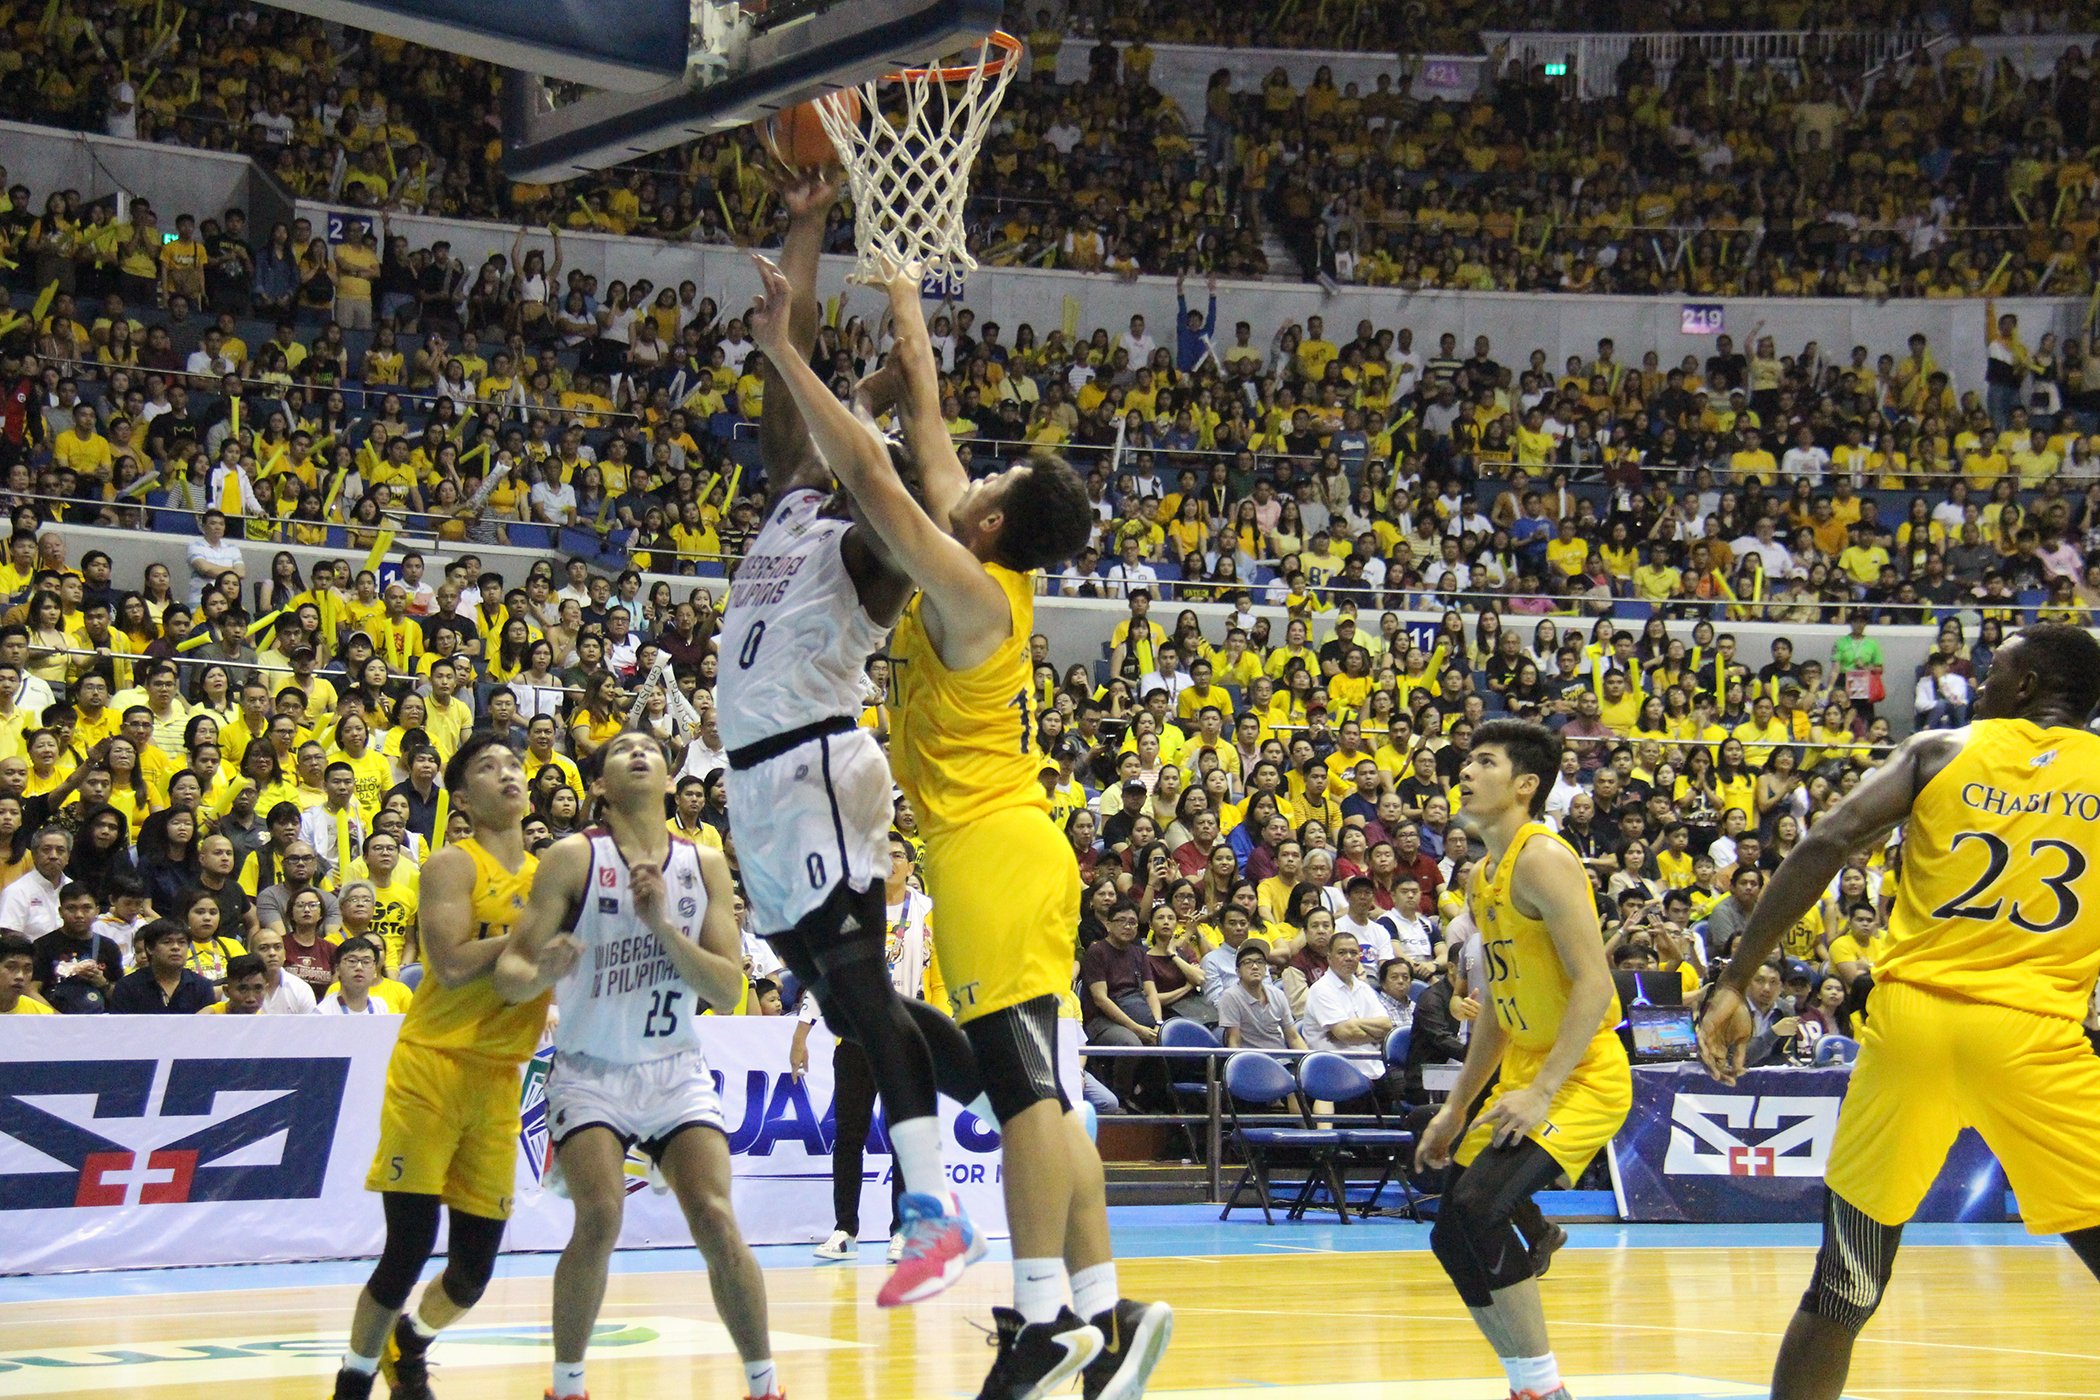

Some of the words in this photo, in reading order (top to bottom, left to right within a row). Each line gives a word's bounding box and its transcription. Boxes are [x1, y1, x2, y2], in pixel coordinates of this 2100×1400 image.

[329, 217, 372, 240] 27
[1682, 309, 1722, 329] 219
[739, 619, 766, 671] 0
[1408, 627, 1435, 652] 11
[355, 784, 380, 793] ELLO
[1962, 783, 2051, 816] CHABI
[2062, 792, 2100, 821] YO
[806, 852, 828, 890] 0
[1932, 832, 2087, 933] 23
[1787, 920, 1812, 946] UST
[644, 990, 682, 1037] 25
[1497, 997, 1528, 1031] 11
[390, 1156, 404, 1181] 5
